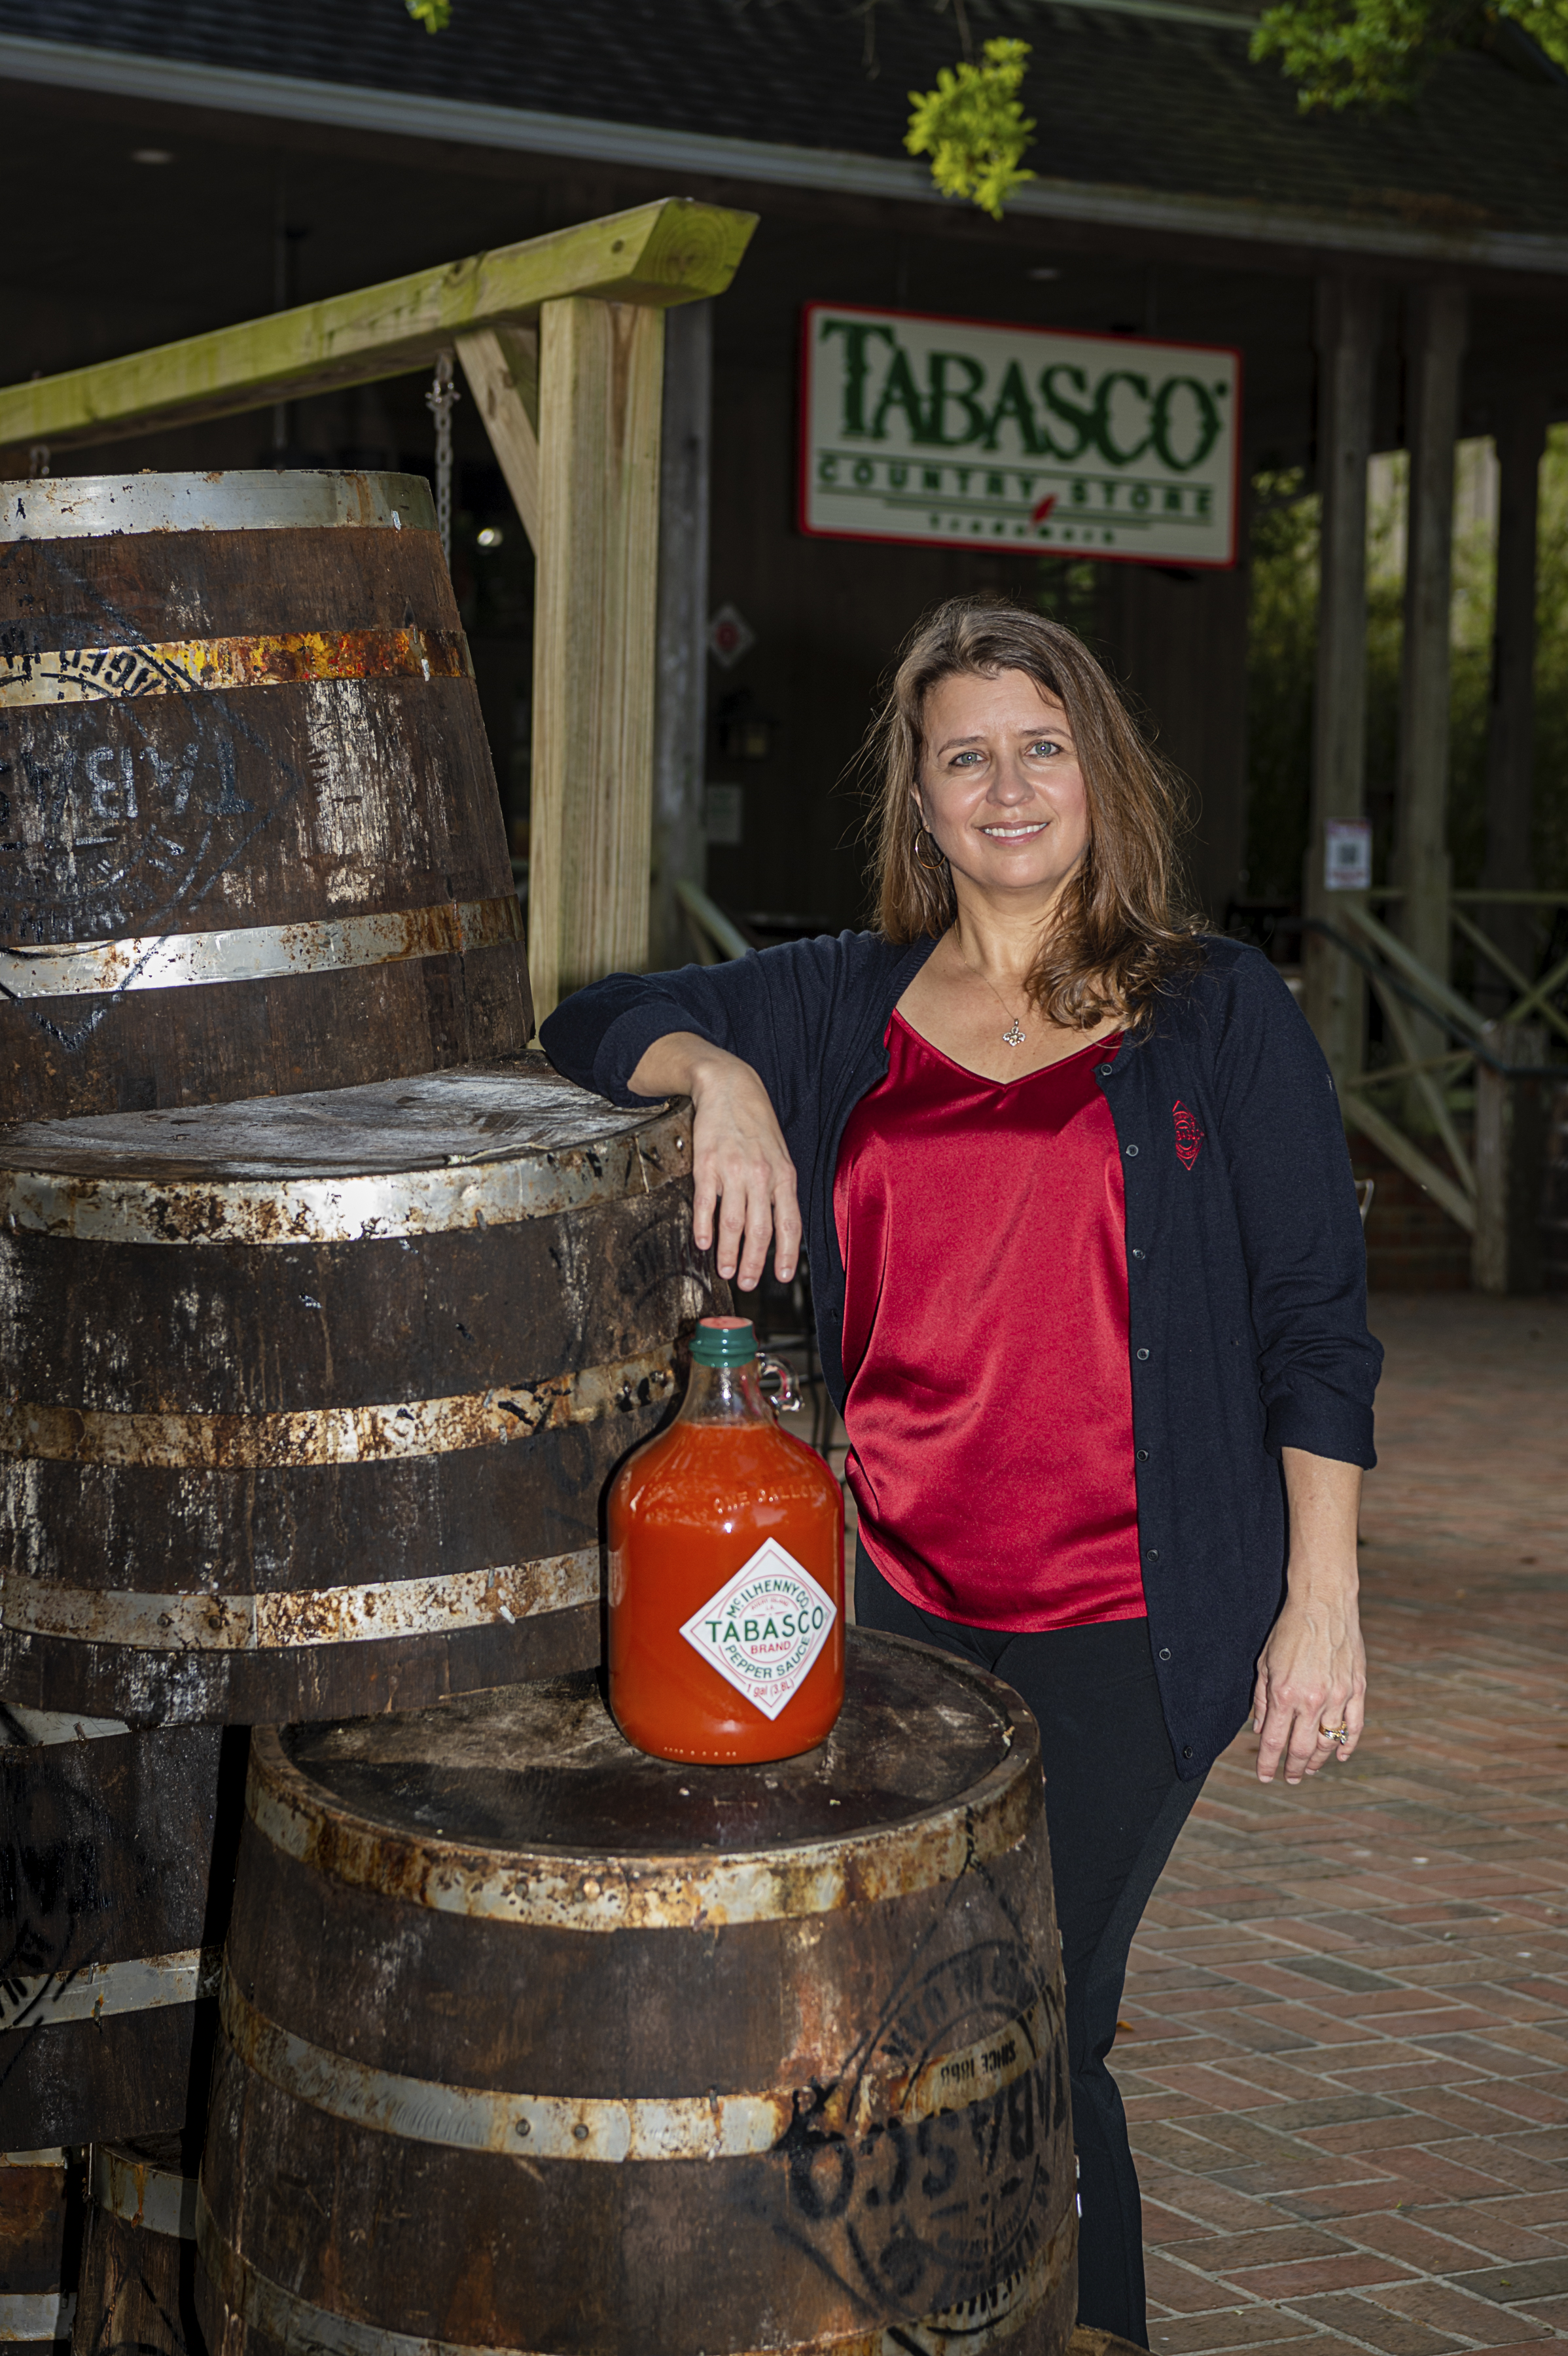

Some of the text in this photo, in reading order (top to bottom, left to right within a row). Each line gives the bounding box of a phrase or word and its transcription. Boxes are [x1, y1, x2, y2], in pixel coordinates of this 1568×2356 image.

[820, 317, 1222, 471] TABASCO
[817, 454, 1215, 515] COUNTRY STORE
[705, 1605, 823, 1643] TABASCO
[726, 1636, 810, 1679] PEPPER SAUCE
[751, 1641, 791, 1654] BRAND
[747, 1683, 751, 1692] 1
[754, 1685, 768, 1697] gal
[940, 2039, 1016, 2086] SINCE 1868
